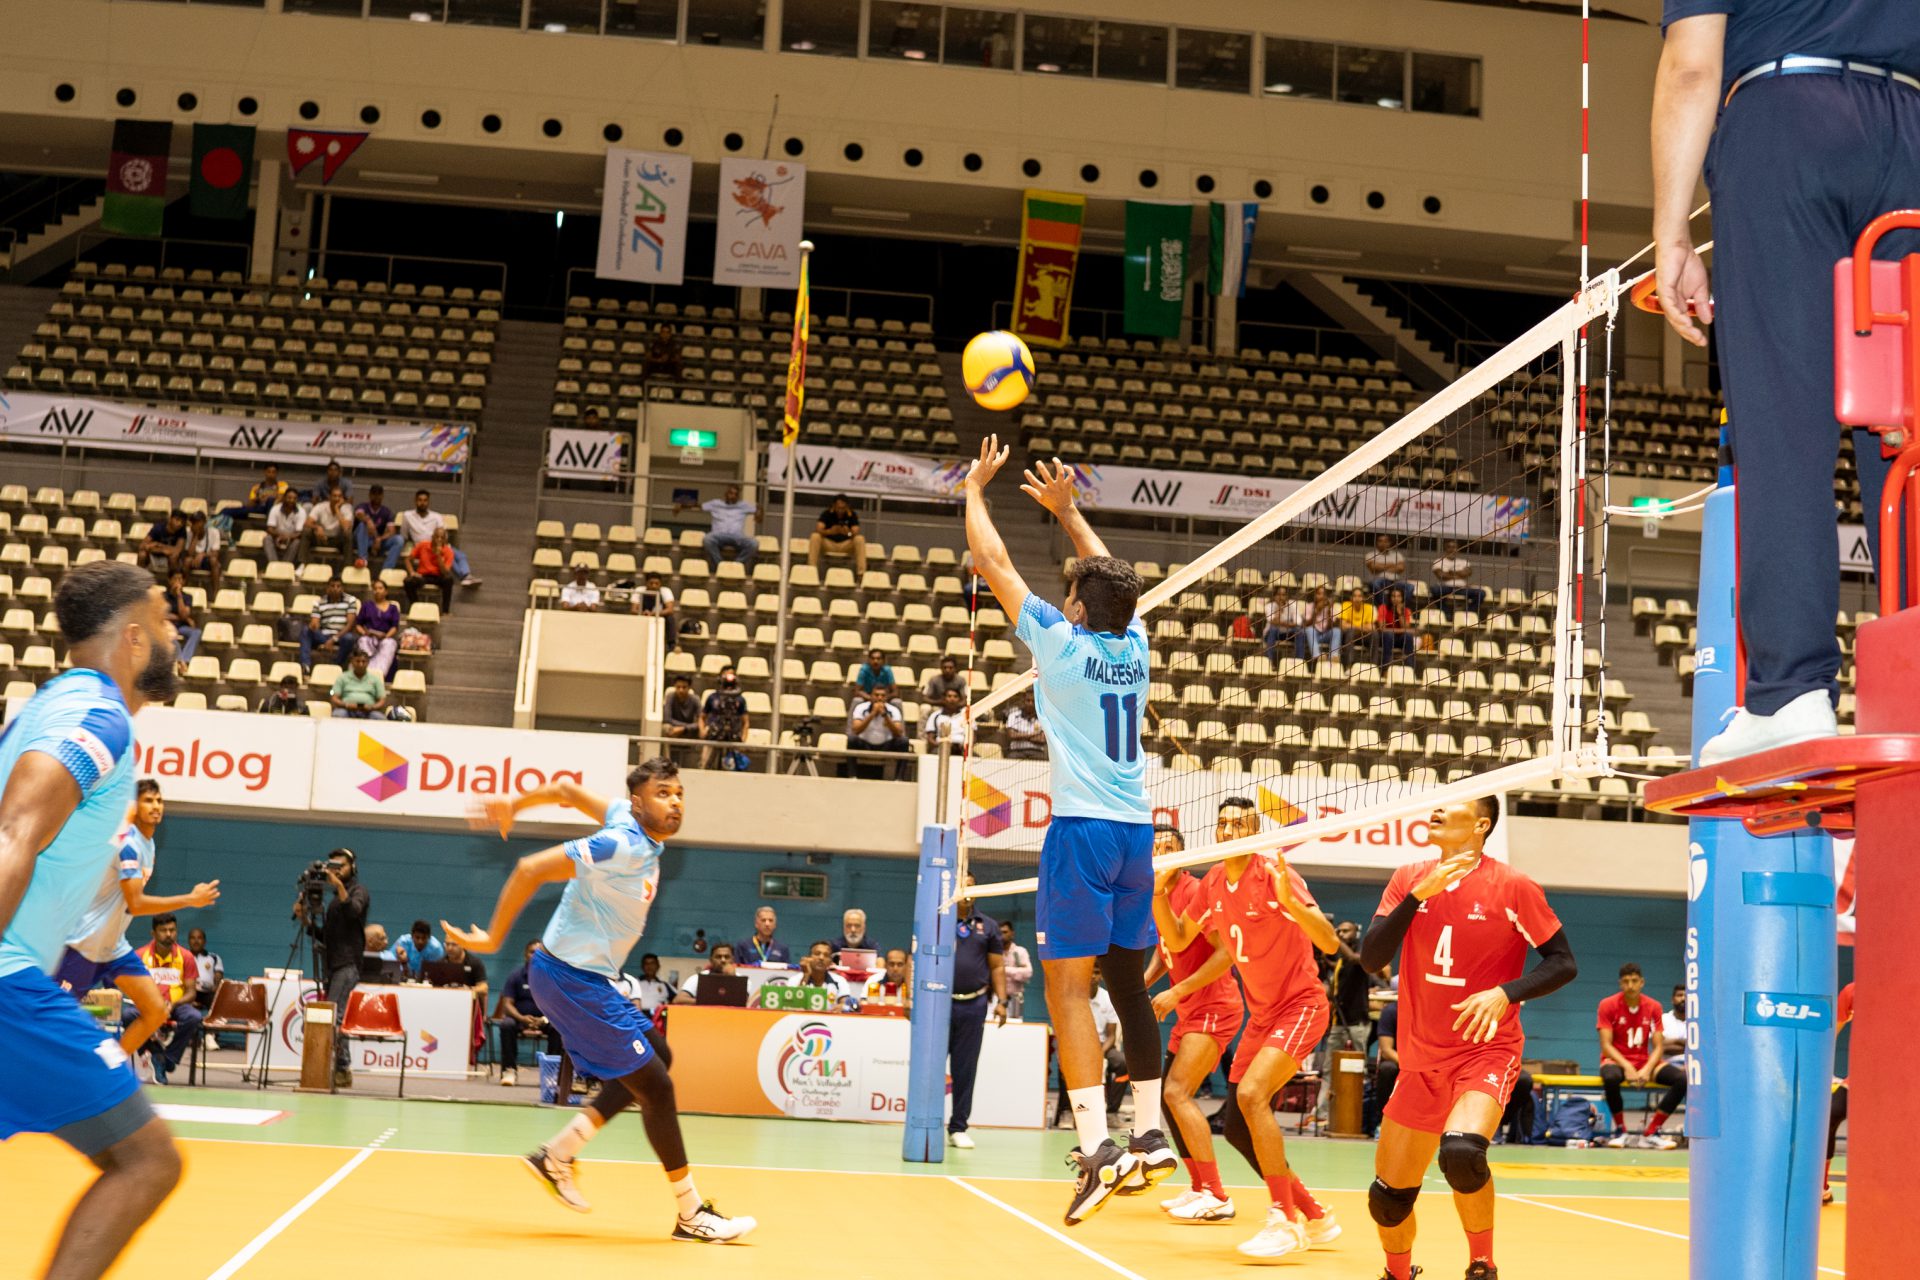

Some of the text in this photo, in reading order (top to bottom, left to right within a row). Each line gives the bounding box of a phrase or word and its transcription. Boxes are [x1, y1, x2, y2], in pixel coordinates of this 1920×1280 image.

[632, 183, 667, 272] AVC
[731, 241, 788, 261] CAVA
[1243, 488, 1270, 498] DSI
[1083, 656, 1146, 685] MALEESHA
[1100, 692, 1137, 763] 11
[1317, 806, 1432, 848] Dialo
[1467, 913, 1487, 921] NEPAL
[1230, 924, 1249, 962] 2
[1433, 925, 1454, 977] 4
[765, 991, 780, 1009] 8
[810, 994, 825, 1011] 9
[632, 1039, 645, 1055] 8
[1627, 1026, 1643, 1048] 14
[799, 1059, 847, 1078] CAVA
[802, 1095, 841, 1108] Colombo
[871, 1092, 906, 1112] Dia
